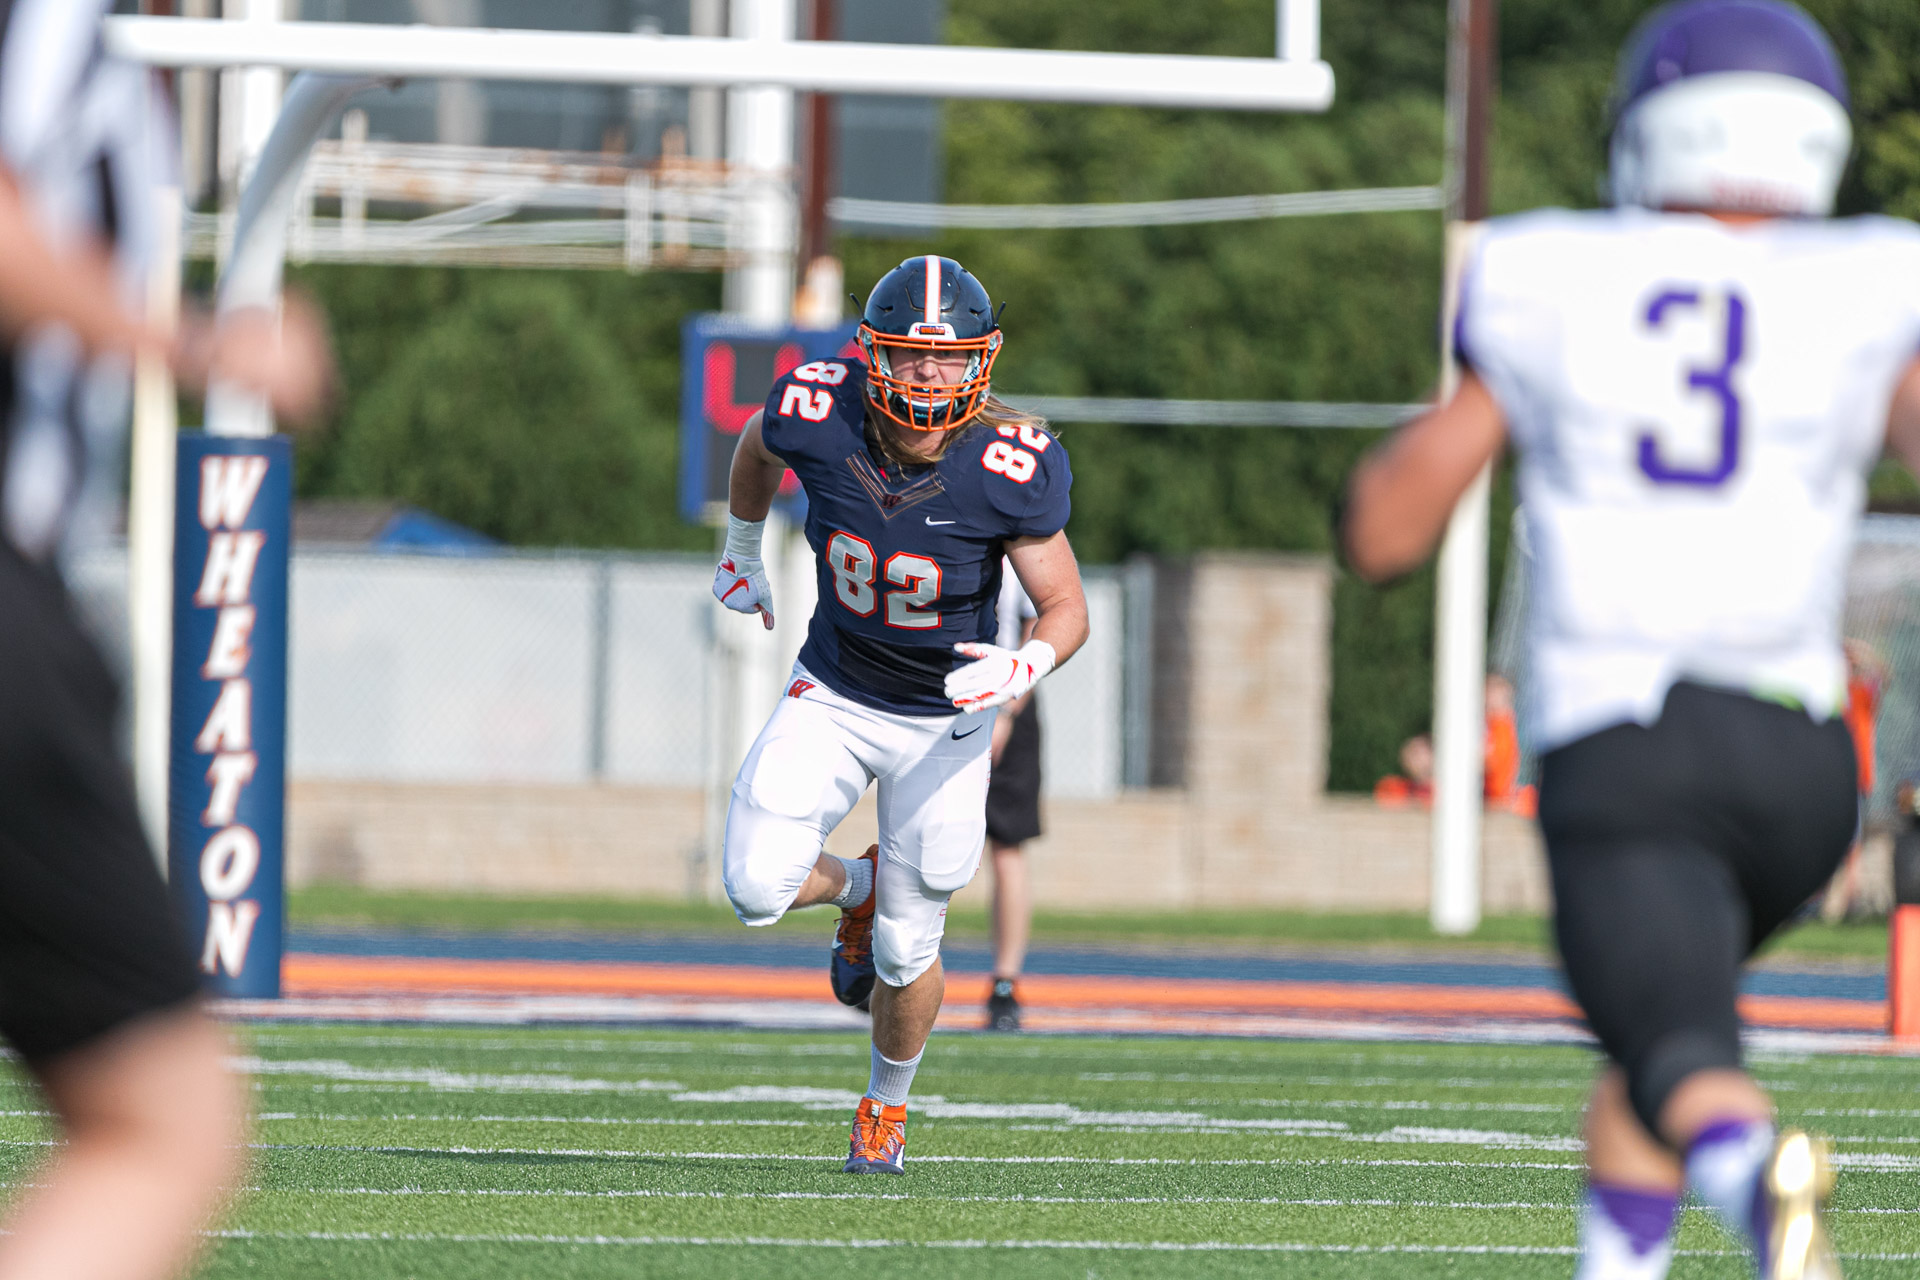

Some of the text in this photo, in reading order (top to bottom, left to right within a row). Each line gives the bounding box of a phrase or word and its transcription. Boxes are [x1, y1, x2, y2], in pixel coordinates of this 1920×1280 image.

[778, 361, 849, 423] 82
[1637, 290, 1745, 486] 3
[981, 424, 1051, 485] 82
[826, 529, 943, 631] 82
[194, 455, 269, 978] WHEATON
